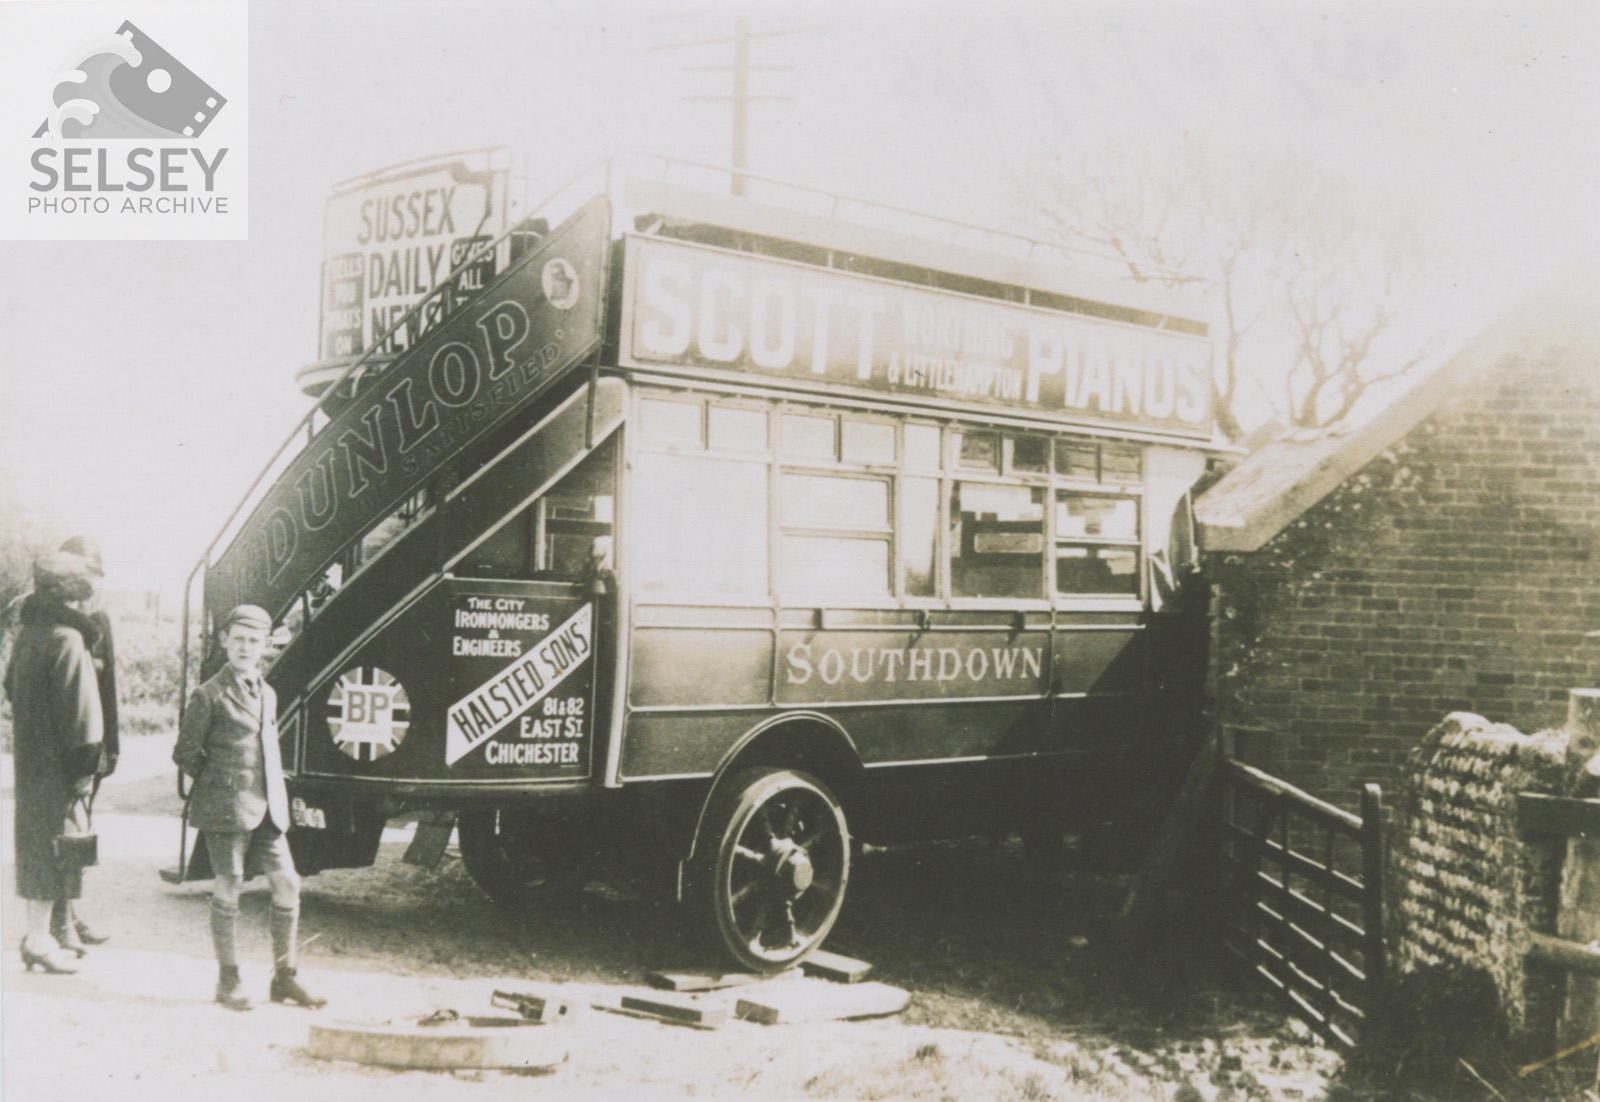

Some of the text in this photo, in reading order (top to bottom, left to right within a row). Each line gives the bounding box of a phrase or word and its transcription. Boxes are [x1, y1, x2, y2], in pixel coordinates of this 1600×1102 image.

[358, 186, 456, 245] SUSSEX
[369, 243, 444, 299] DAILY
[457, 268, 485, 291] ALL
[641, 258, 887, 380] SCOTT
[904, 300, 1013, 359] WORTHING
[904, 353, 1022, 400] LITTLEHAMPTON
[1026, 326, 1207, 422] PIANOS
[261, 300, 529, 586] DUNLOP
[454, 608, 550, 632] IRONMONGERS
[467, 597, 526, 611] THE CITY
[452, 634, 522, 657] ENGINEERS
[488, 629, 500, 639] &
[451, 621, 588, 744] HALSTED SONS
[786, 643, 1044, 685] SOUTHDOWN
[345, 690, 390, 725] BP
[520, 715, 563, 739] EAST
[485, 740, 580, 765] CHICHESTER
